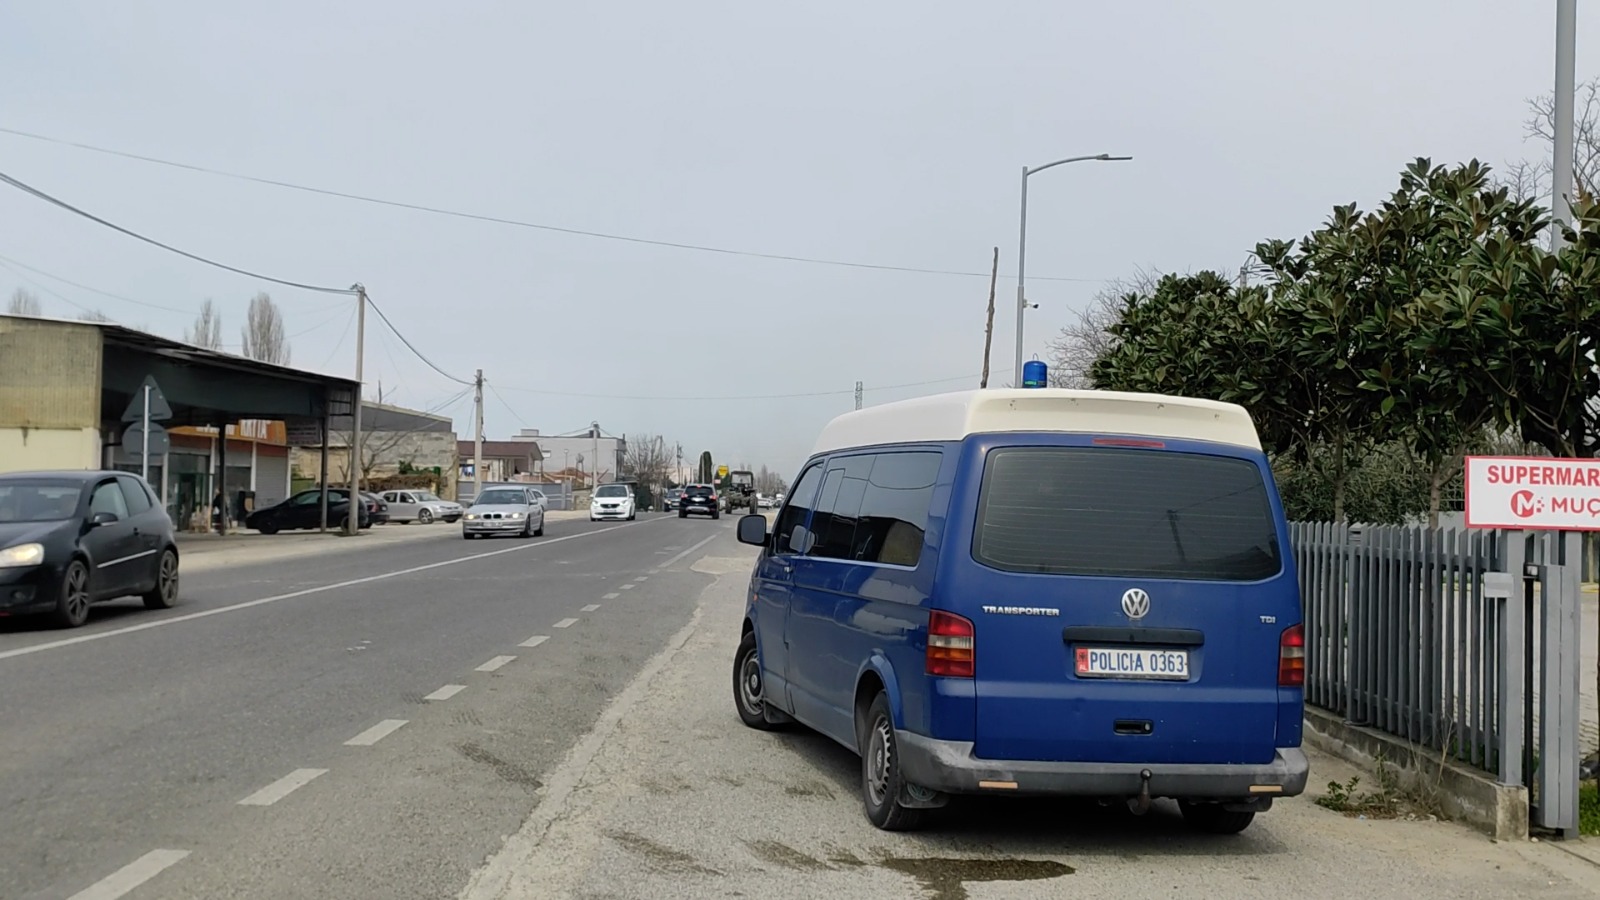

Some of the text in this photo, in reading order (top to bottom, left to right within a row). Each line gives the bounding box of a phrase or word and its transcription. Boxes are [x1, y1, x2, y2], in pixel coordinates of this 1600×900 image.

[1487, 465, 1600, 486] SUPERMAR
[982, 605, 1060, 616] TRANSPORTER
[1259, 615, 1276, 624] TDI
[1090, 651, 1184, 672] POLICIA 0363
